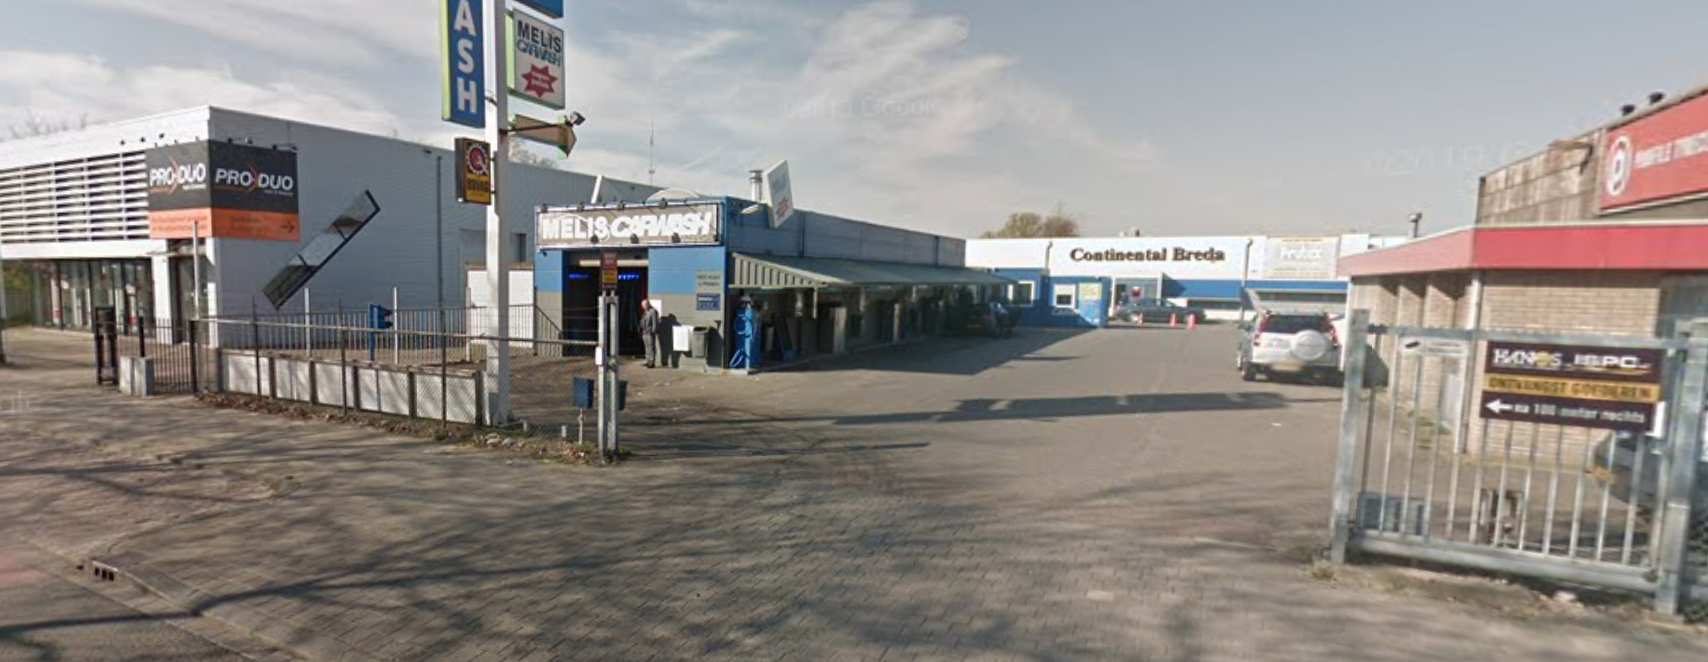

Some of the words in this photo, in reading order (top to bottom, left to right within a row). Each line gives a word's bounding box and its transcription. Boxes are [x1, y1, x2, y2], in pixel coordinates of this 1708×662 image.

[516, 20, 561, 53] MELIS
[542, 215, 609, 240] MELIS
[610, 211, 713, 238] CARWASH
[1070, 247, 1167, 262] Continental
[1172, 247, 1225, 262] Breda
[1488, 376, 1568, 395] ONTVANGST
[1570, 382, 1652, 400] GOEDEREN
